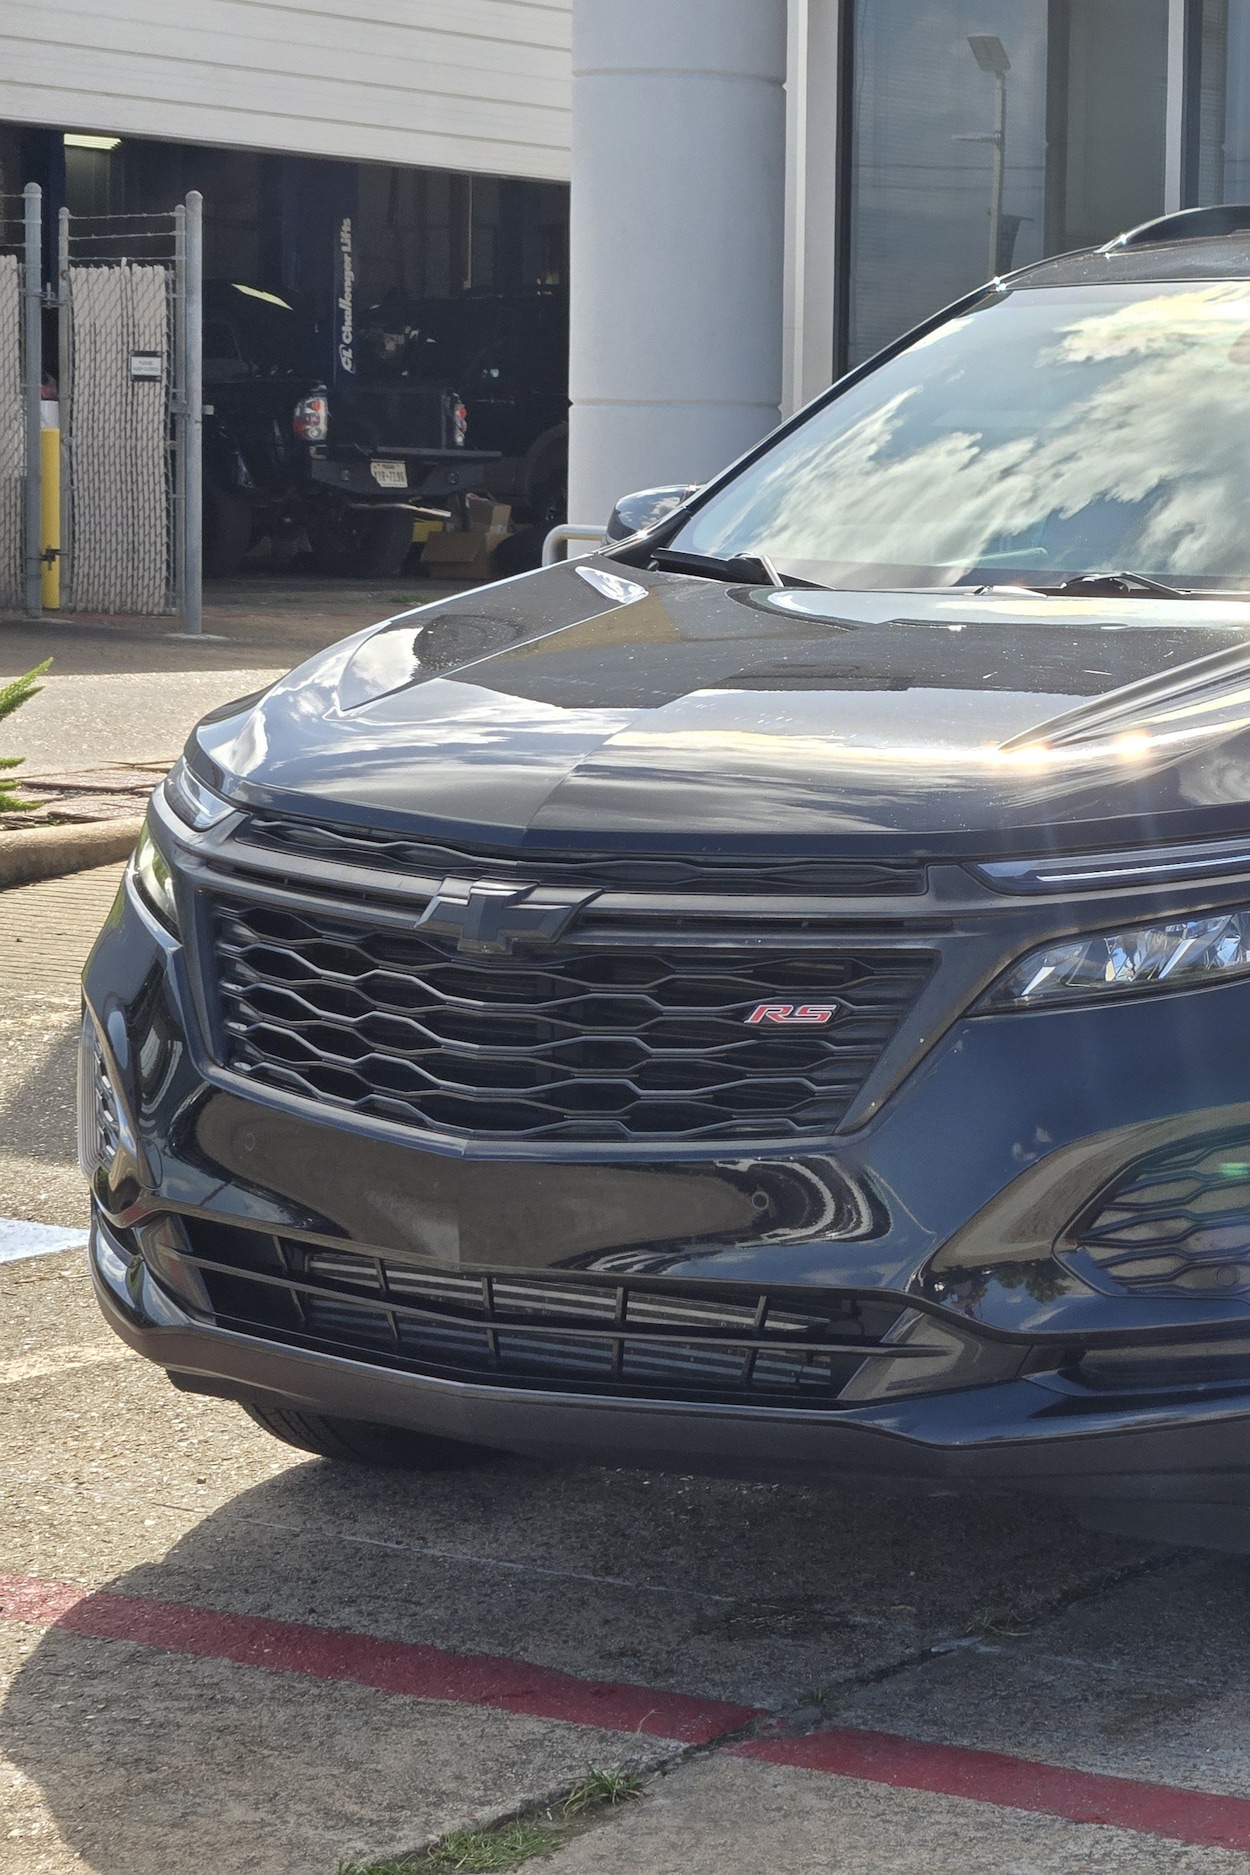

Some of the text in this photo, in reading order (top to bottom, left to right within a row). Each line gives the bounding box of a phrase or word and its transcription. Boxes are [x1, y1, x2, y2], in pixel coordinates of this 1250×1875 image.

[340, 218, 352, 252] Lifts
[339, 253, 354, 344] Challenger
[744, 1004, 837, 1023] RS
